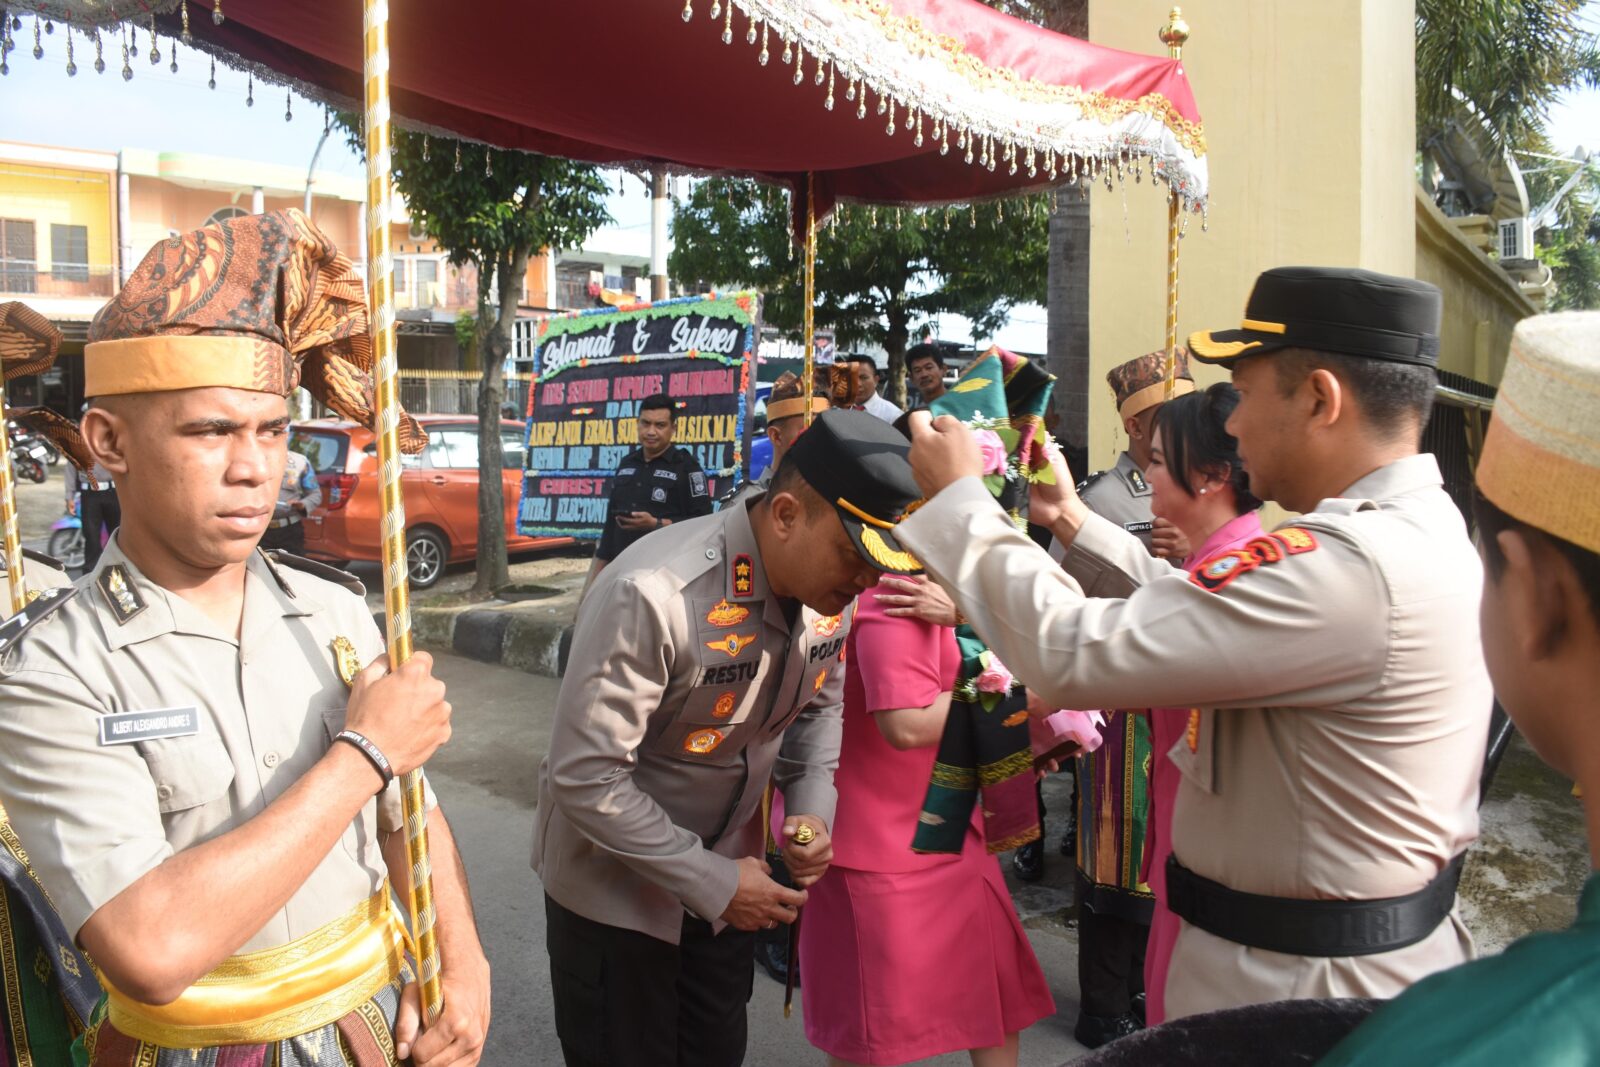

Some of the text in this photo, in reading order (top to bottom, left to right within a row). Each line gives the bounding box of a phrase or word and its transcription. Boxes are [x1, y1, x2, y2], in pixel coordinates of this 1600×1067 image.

[543, 315, 738, 375] Selamat & Sukses
[584, 418, 614, 446] ERMA
[540, 477, 606, 496] CHRIST
[810, 636, 844, 664] POLRI
[702, 660, 760, 686] RESTU
[112, 720, 133, 735] ALBERT
